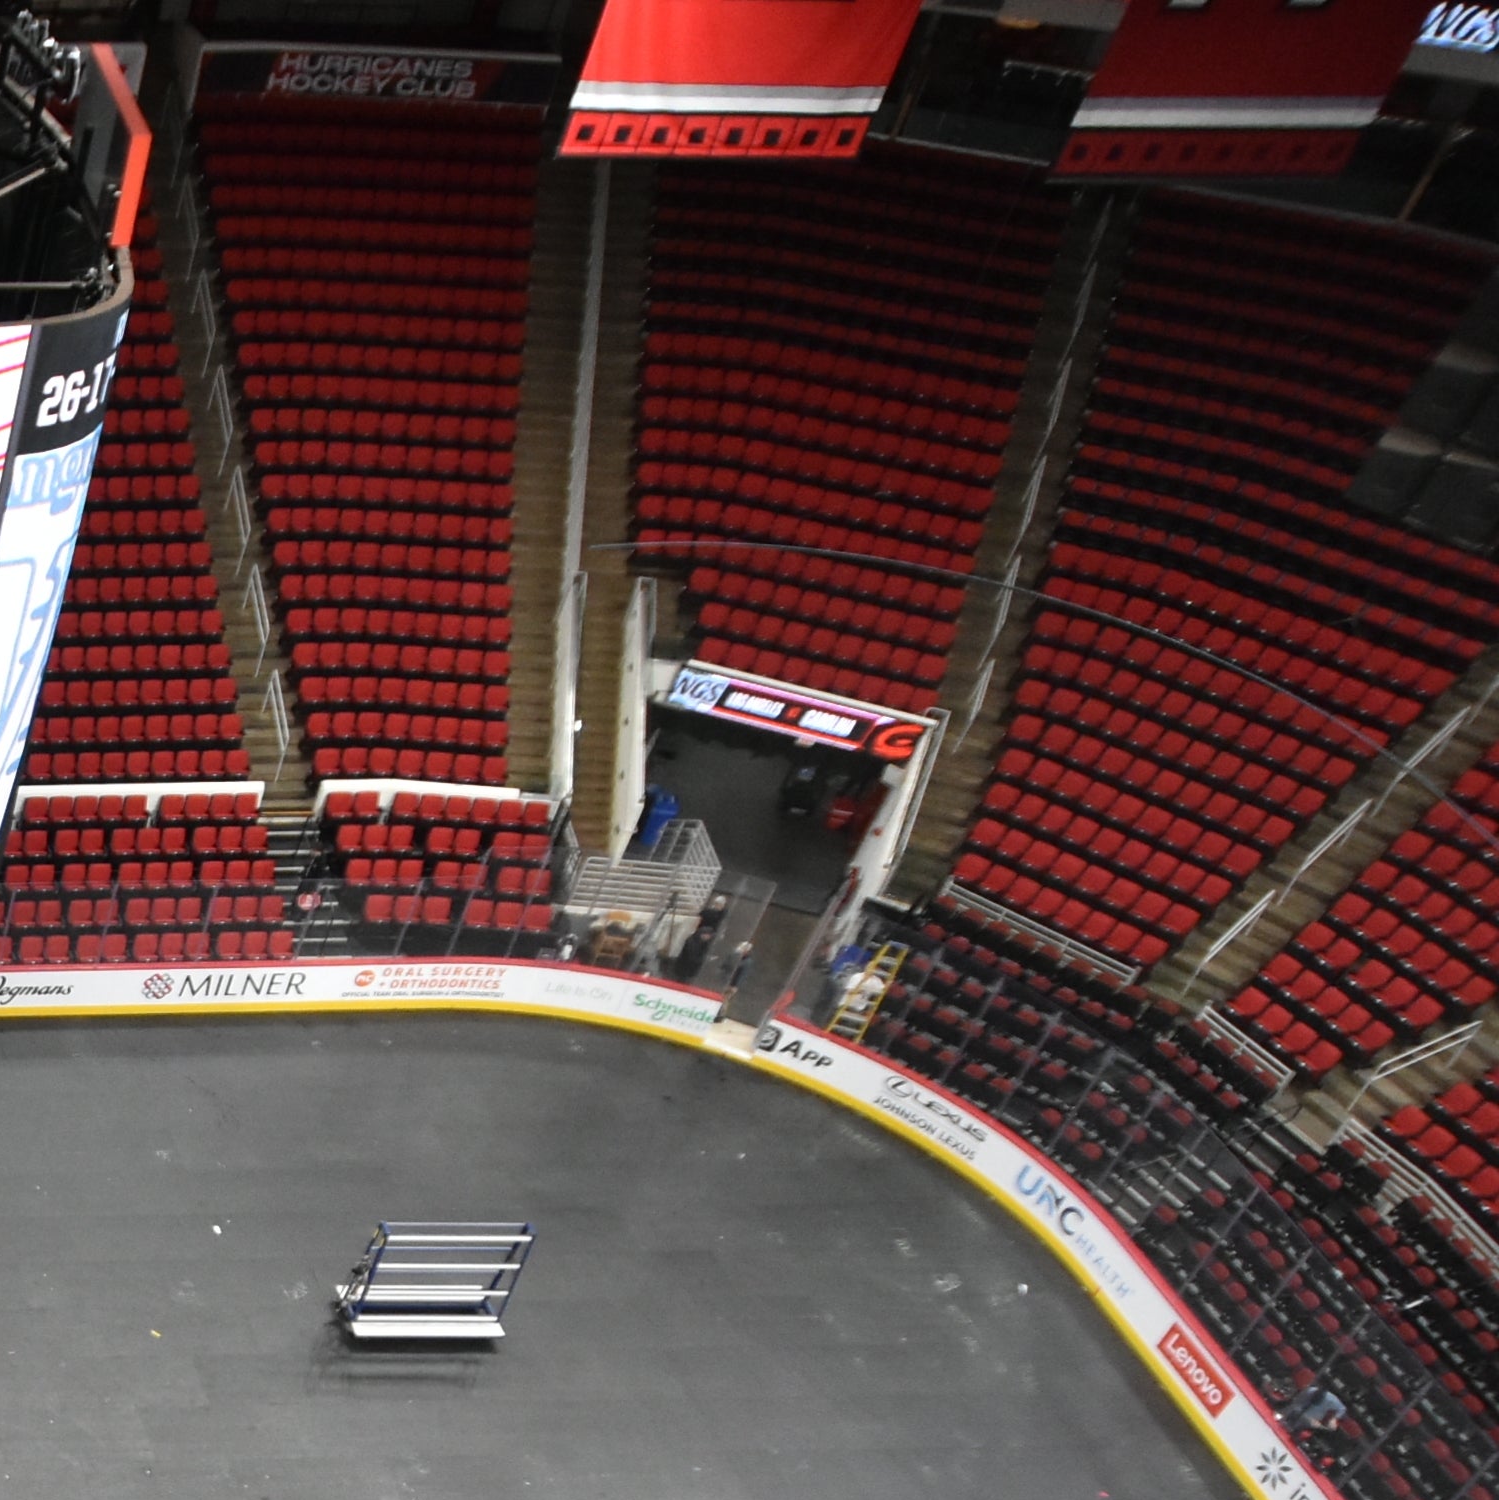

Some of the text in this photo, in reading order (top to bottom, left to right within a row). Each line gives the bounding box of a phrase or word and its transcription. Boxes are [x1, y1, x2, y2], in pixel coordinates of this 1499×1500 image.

[281, 52, 474, 78] HURRICANES
[267, 73, 477, 98] HOCKEY CLUB
[382, 966, 507, 977] ORAL SURGERY
[390, 979, 501, 989] ORTHODONTICS
[179, 973, 307, 998] MILNER
[874, 1095, 976, 1162] JOHNSON LEXUS
[914, 1091, 988, 1143] LEXUS
[1016, 1164, 1085, 1235] UNC
[1167, 1333, 1223, 1405] Lenovo
